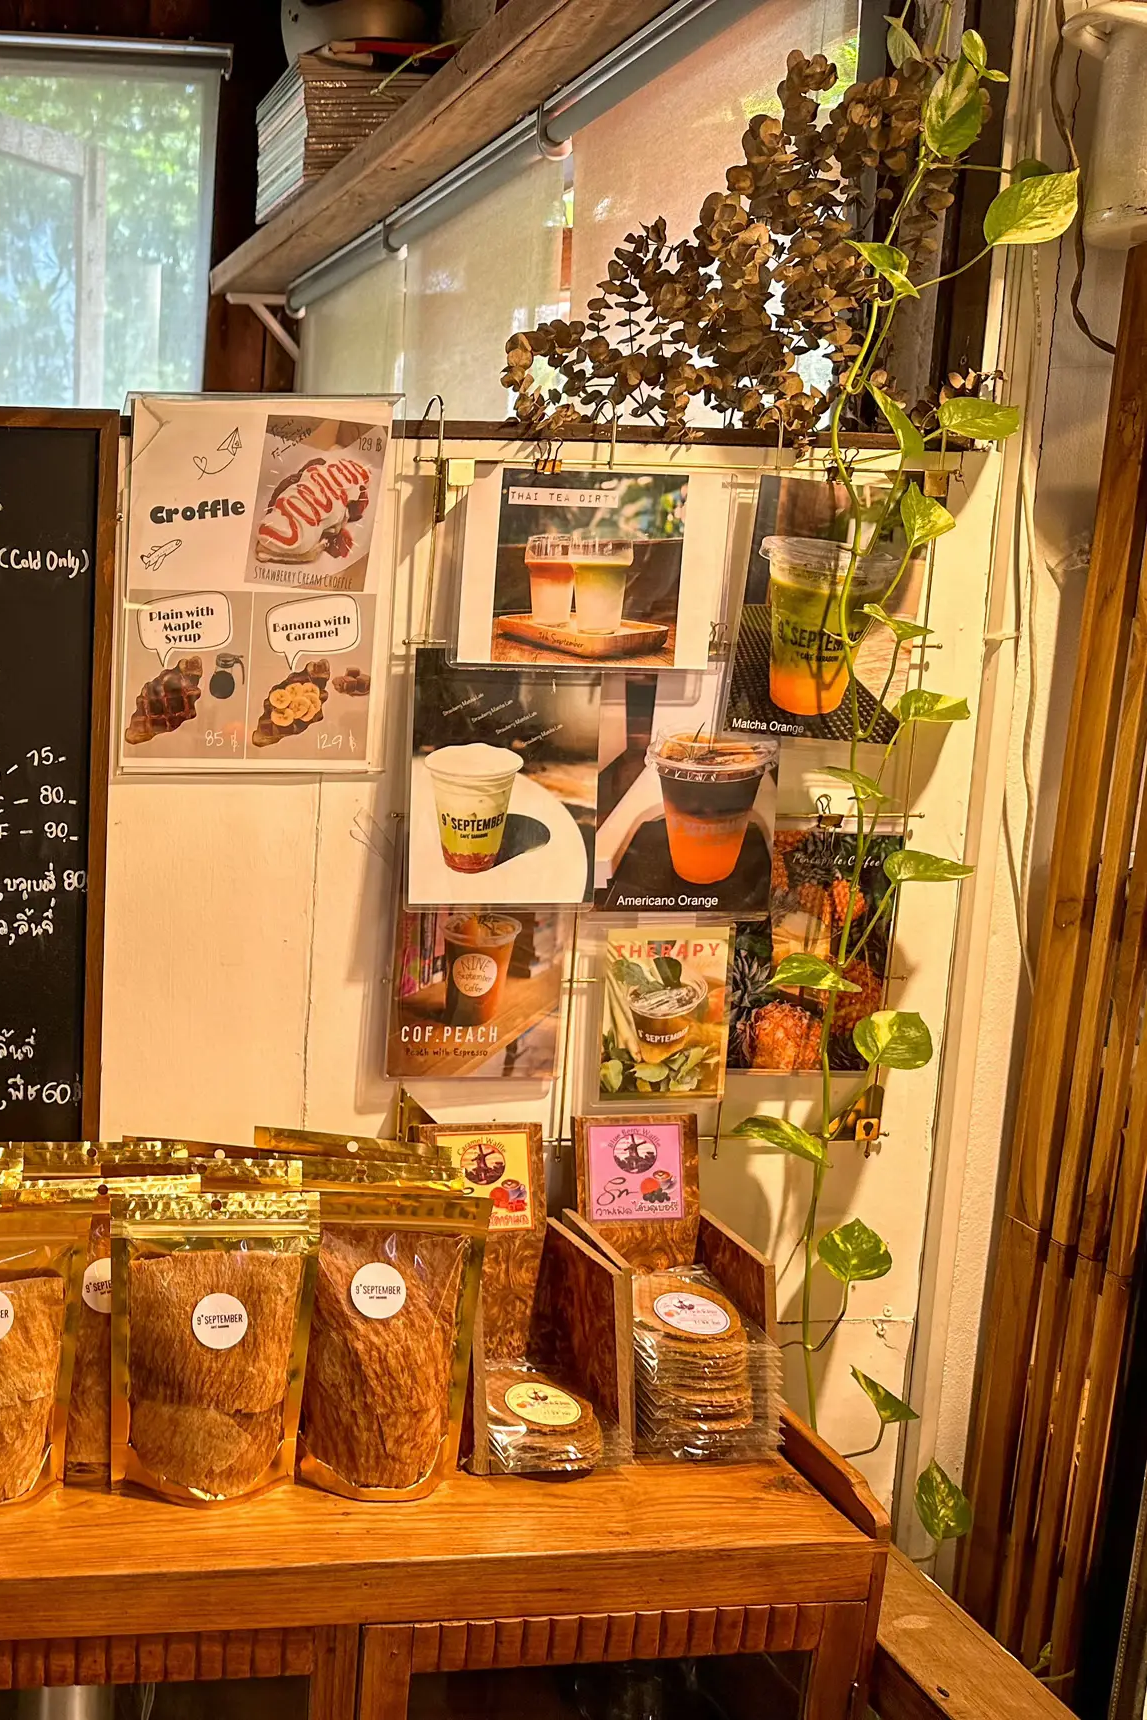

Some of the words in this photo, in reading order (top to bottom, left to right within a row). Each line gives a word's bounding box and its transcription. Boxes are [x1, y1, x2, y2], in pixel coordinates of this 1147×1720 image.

[358, 437, 373, 451] 129
[510, 491, 539, 501] THAI
[549, 493, 570, 502] TEA
[579, 494, 618, 504] DIRTY
[150, 498, 246, 525] Croffle
[45, 548, 90, 579] Only)
[149, 609, 183, 622] Plain
[186, 606, 214, 618] with
[162, 620, 202, 633] Maple
[273, 620, 321, 633] Banana
[323, 615, 351, 627] with
[164, 632, 202, 645] Syrup
[286, 627, 339, 642] Caramel
[732, 717, 767, 731] Matcha
[769, 720, 804, 734] Orange
[205, 729, 224, 747] 85
[317, 733, 343, 750] 129
[617, 895, 675, 906] Americano
[678, 894, 719, 908] Orange
[616, 943, 720, 959] THERAPY
[453, 1048, 488, 1057] Espresso
[42, 1081, 71, 1105] 60
[362, 1285, 401, 1295] SEPTEMBER
[204, 1313, 244, 1325] SEPTEMBER
